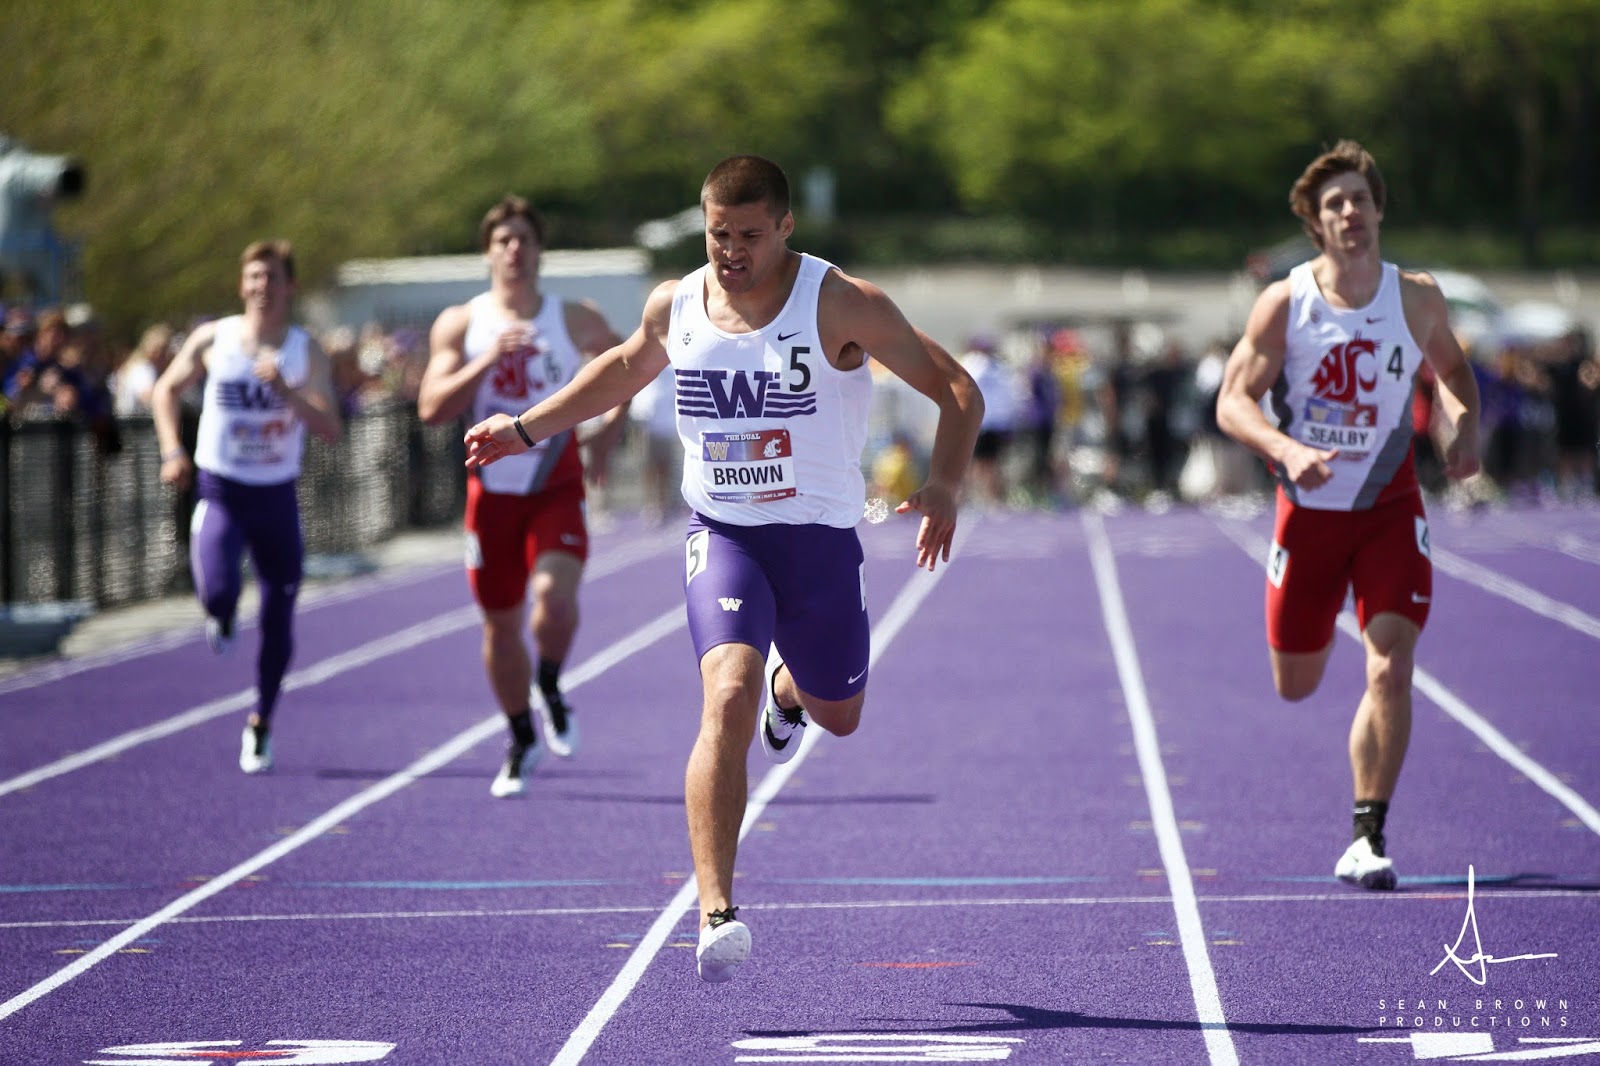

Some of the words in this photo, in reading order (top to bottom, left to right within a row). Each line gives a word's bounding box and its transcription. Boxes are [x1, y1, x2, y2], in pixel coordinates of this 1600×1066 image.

[789, 346, 811, 393] 5
[1387, 345, 1404, 381] 4
[702, 370, 774, 419] W
[1309, 426, 1369, 446] SEALBY
[706, 442, 729, 460] W
[713, 464, 783, 486] BROWN
[689, 532, 701, 578] 5
[718, 597, 743, 612] W
